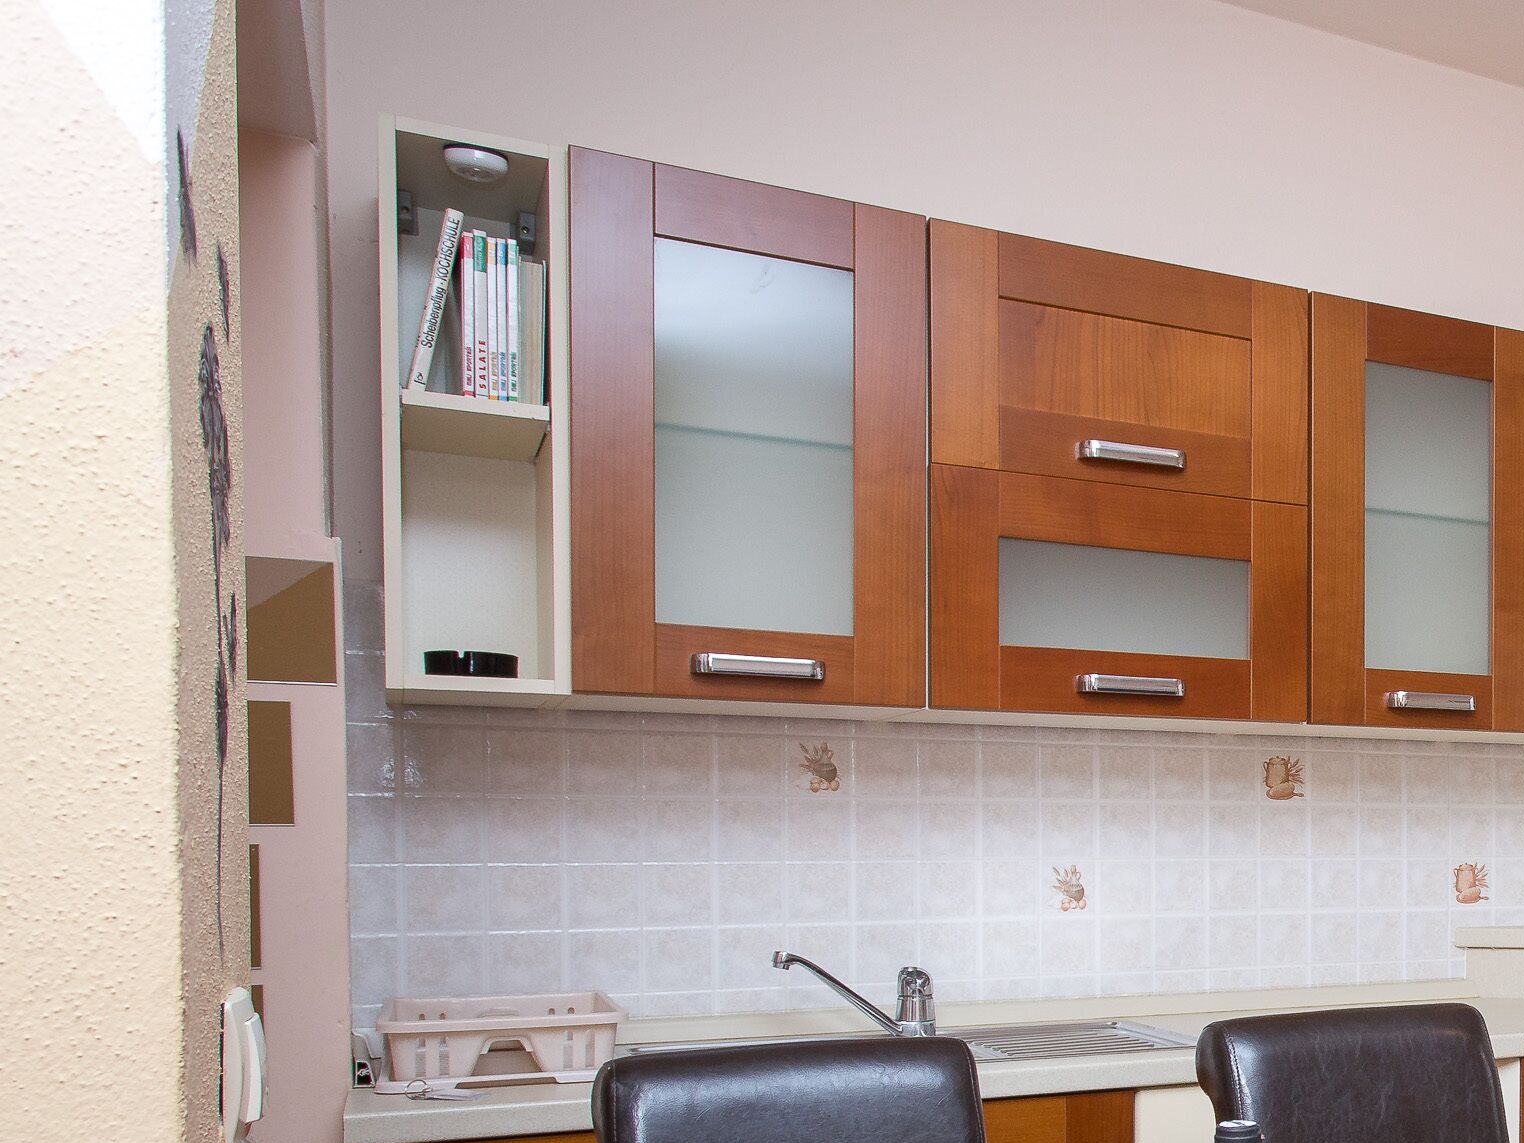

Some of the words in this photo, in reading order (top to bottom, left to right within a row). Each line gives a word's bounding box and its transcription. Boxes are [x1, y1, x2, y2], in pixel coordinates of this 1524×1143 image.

[421, 286, 446, 348] Scheibenpflug
[436, 217, 460, 282] KOCHSCHULE
[478, 340, 487, 390] SALATE
